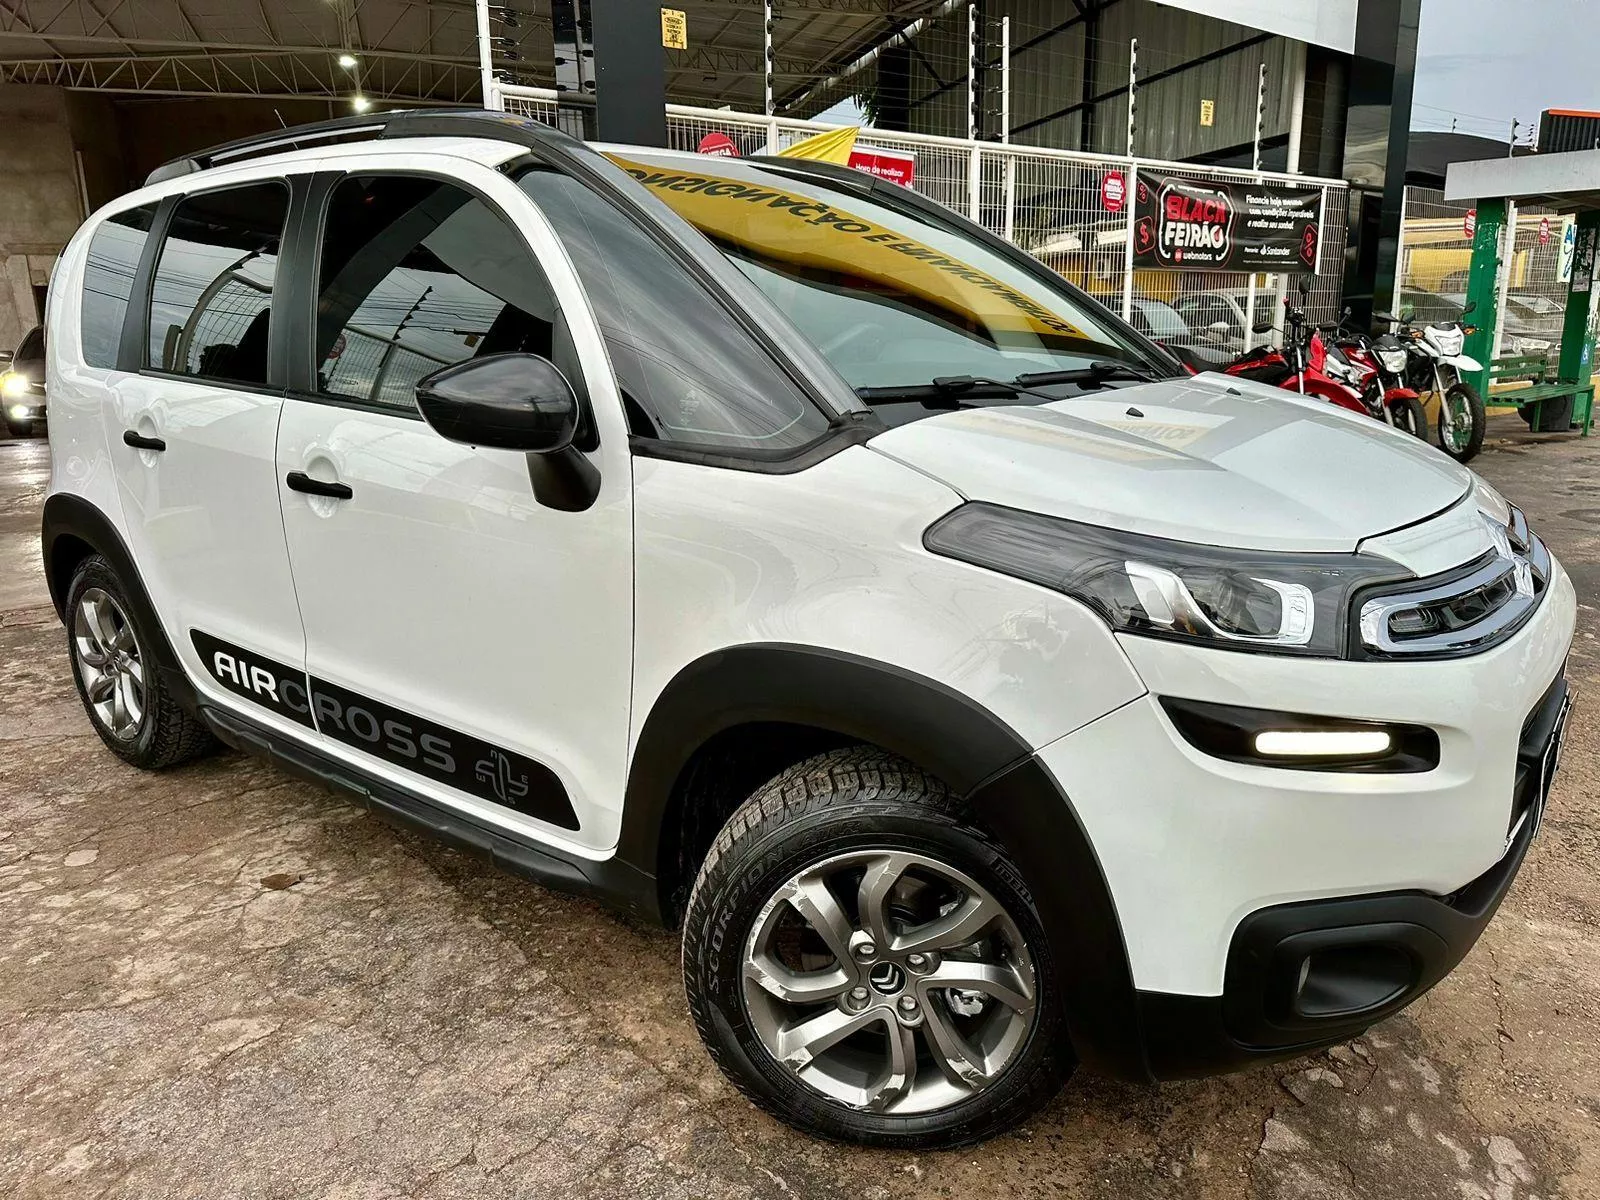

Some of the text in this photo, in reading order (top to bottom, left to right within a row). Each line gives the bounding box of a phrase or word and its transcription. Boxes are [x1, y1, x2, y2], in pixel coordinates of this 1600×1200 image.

[1167, 195, 1226, 223] BLACK
[1165, 221, 1225, 249] FEIRÃO
[1183, 252, 1213, 261] webmotors
[1267, 246, 1290, 256] Santander
[214, 651, 456, 774] AIRCROSS
[706, 845, 785, 994] SCORPION
